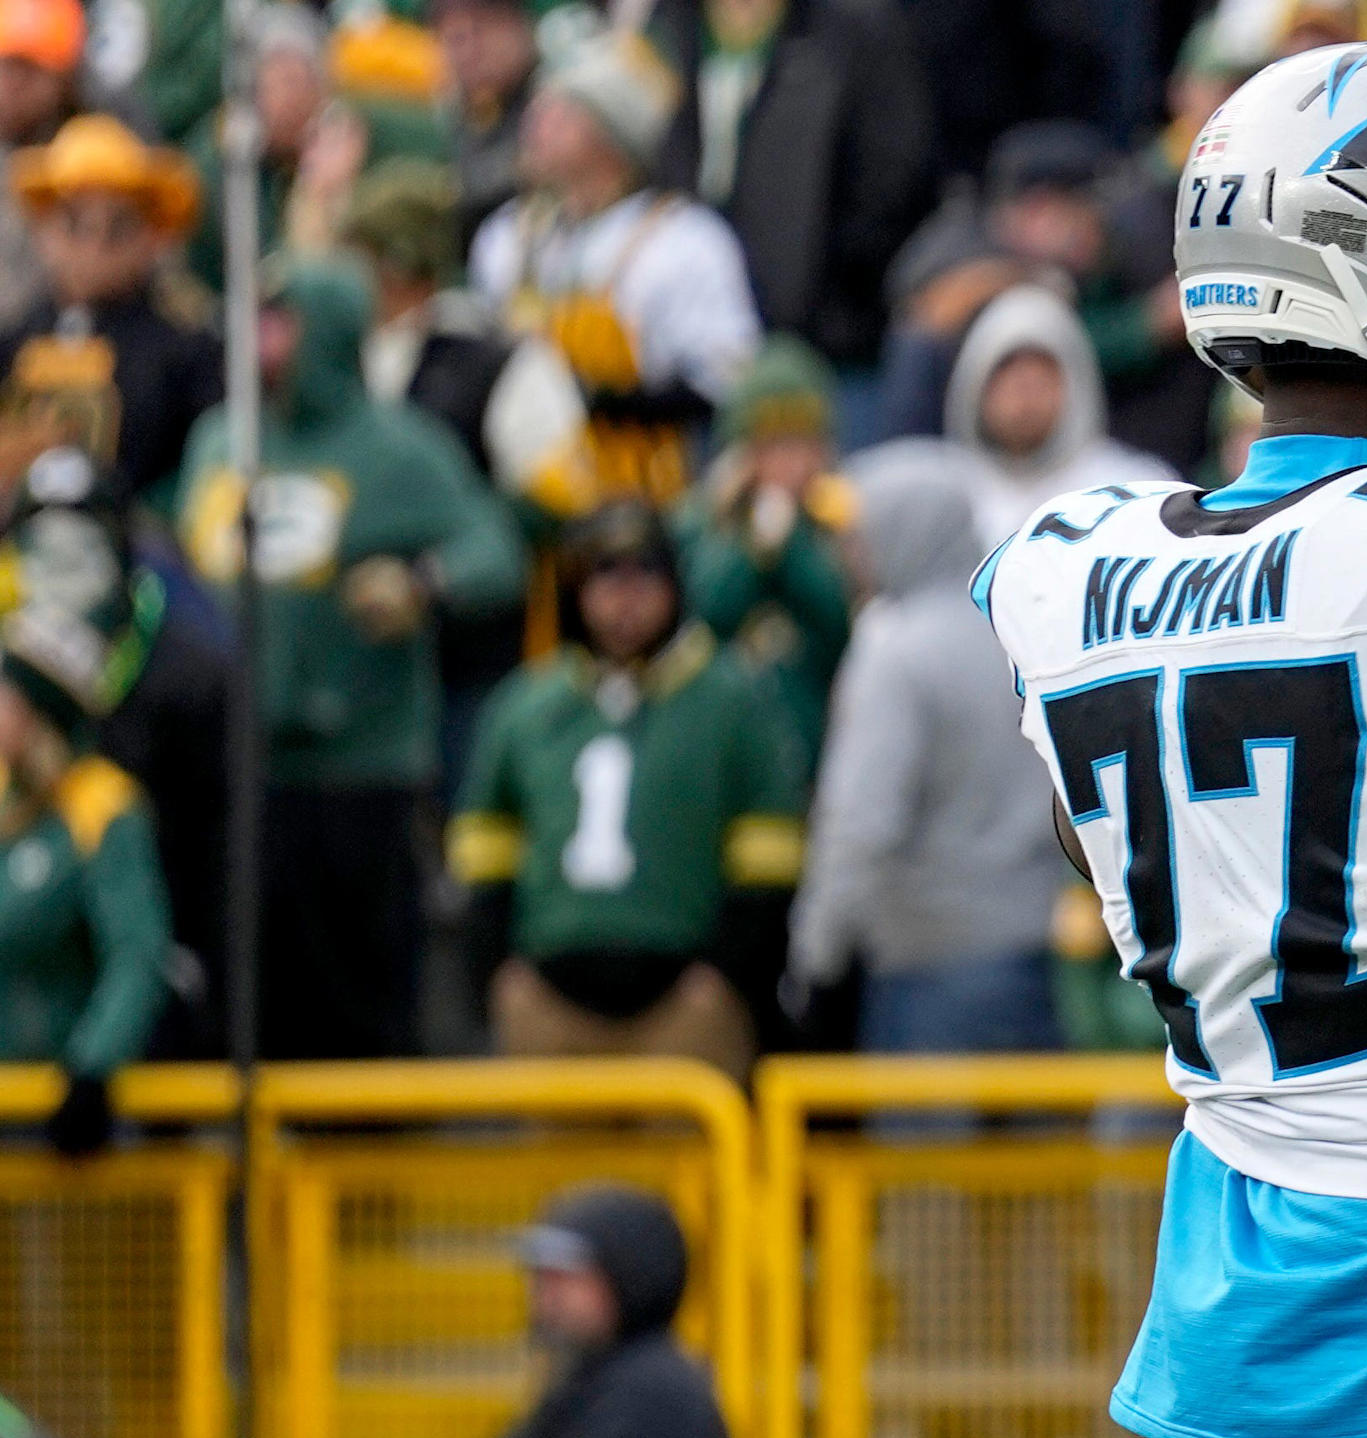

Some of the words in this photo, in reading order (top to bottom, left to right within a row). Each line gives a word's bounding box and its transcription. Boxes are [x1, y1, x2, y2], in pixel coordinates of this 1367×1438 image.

[1189, 174, 1247, 229] 77
[1185, 282, 1259, 310] PANTHERS
[1082, 527, 1304, 651] NIJMAN
[562, 735, 636, 886] 1
